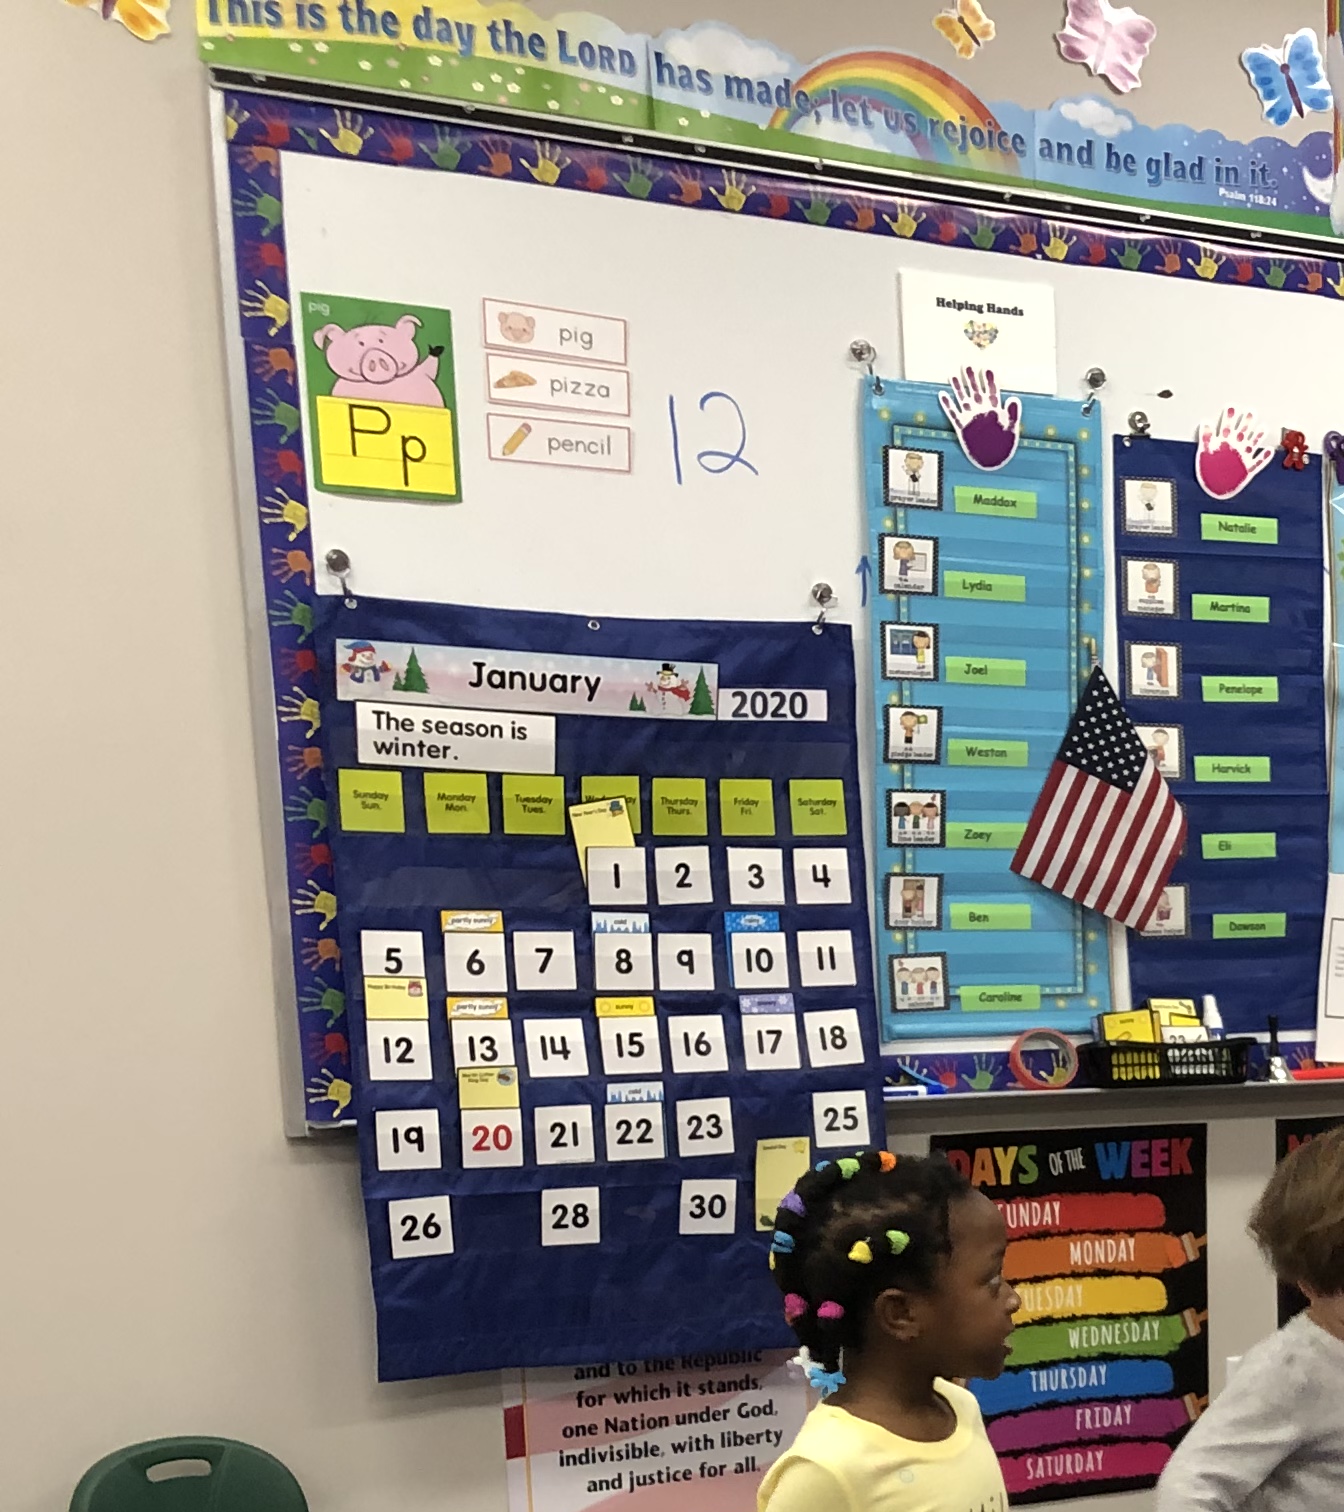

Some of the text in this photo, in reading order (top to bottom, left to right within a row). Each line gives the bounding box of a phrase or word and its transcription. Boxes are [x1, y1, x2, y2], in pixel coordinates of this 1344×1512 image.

[207, 0, 282, 28] This
[299, 3, 326, 32] is
[340, 4, 399, 39] the
[412, 11, 476, 57] day
[487, 20, 547, 60] the
[559, 30, 636, 78] LORD
[654, 50, 712, 94] has
[831, 89, 874, 127] let
[882, 104, 918, 134] us
[927, 117, 1026, 156] rejoice
[1039, 138, 1095, 168] and
[1105, 143, 1137, 176] be
[1145, 151, 1205, 187] glad
[1214, 157, 1239, 185] in
[1250, 159, 1278, 188] it.
[1218, 188, 1245, 202] Psalm
[936, 296, 1024, 317] Helping Hands
[558, 325, 594, 351] pig
[550, 376, 610, 399] pizza
[548, 432, 612, 457] pencil
[668, 390, 759, 486] 12
[973, 493, 1017, 509] Maddox
[1218, 521, 1257, 534] Natalie
[961, 579, 993, 594] Lydia
[469, 661, 602, 702] January
[1219, 683, 1263, 696] Penelope
[730, 691, 808, 720] 2020
[372, 710, 528, 740] The season is
[373, 738, 460, 762] winter.
[353, 789, 389, 801] Sunday
[437, 792, 476, 803] Monday
[797, 797, 837, 808] Saturday
[744, 946, 774, 973] 10
[383, 1035, 415, 1065] 12
[822, 1106, 860, 1133] 25
[471, 1124, 513, 1152] 20
[1049, 1151, 1064, 1176] OF
[1064, 1147, 1087, 1174] THE
[1095, 1137, 1194, 1180] WEEK
[399, 1213, 442, 1242] 26
[1069, 1238, 1136, 1266] MONDAY
[1068, 1320, 1161, 1350] WEDNESDAY
[576, 1375, 763, 1408] for which it stands,
[1029, 1365, 1108, 1394] THURSDAY
[562, 1399, 779, 1439] one Nation under God,
[1075, 1404, 1132, 1431] FRIDAY
[558, 1429, 784, 1467] indivisible, with liberty
[586, 1456, 761, 1493] and justice for all.
[1026, 1450, 1105, 1480] SATURDAY
